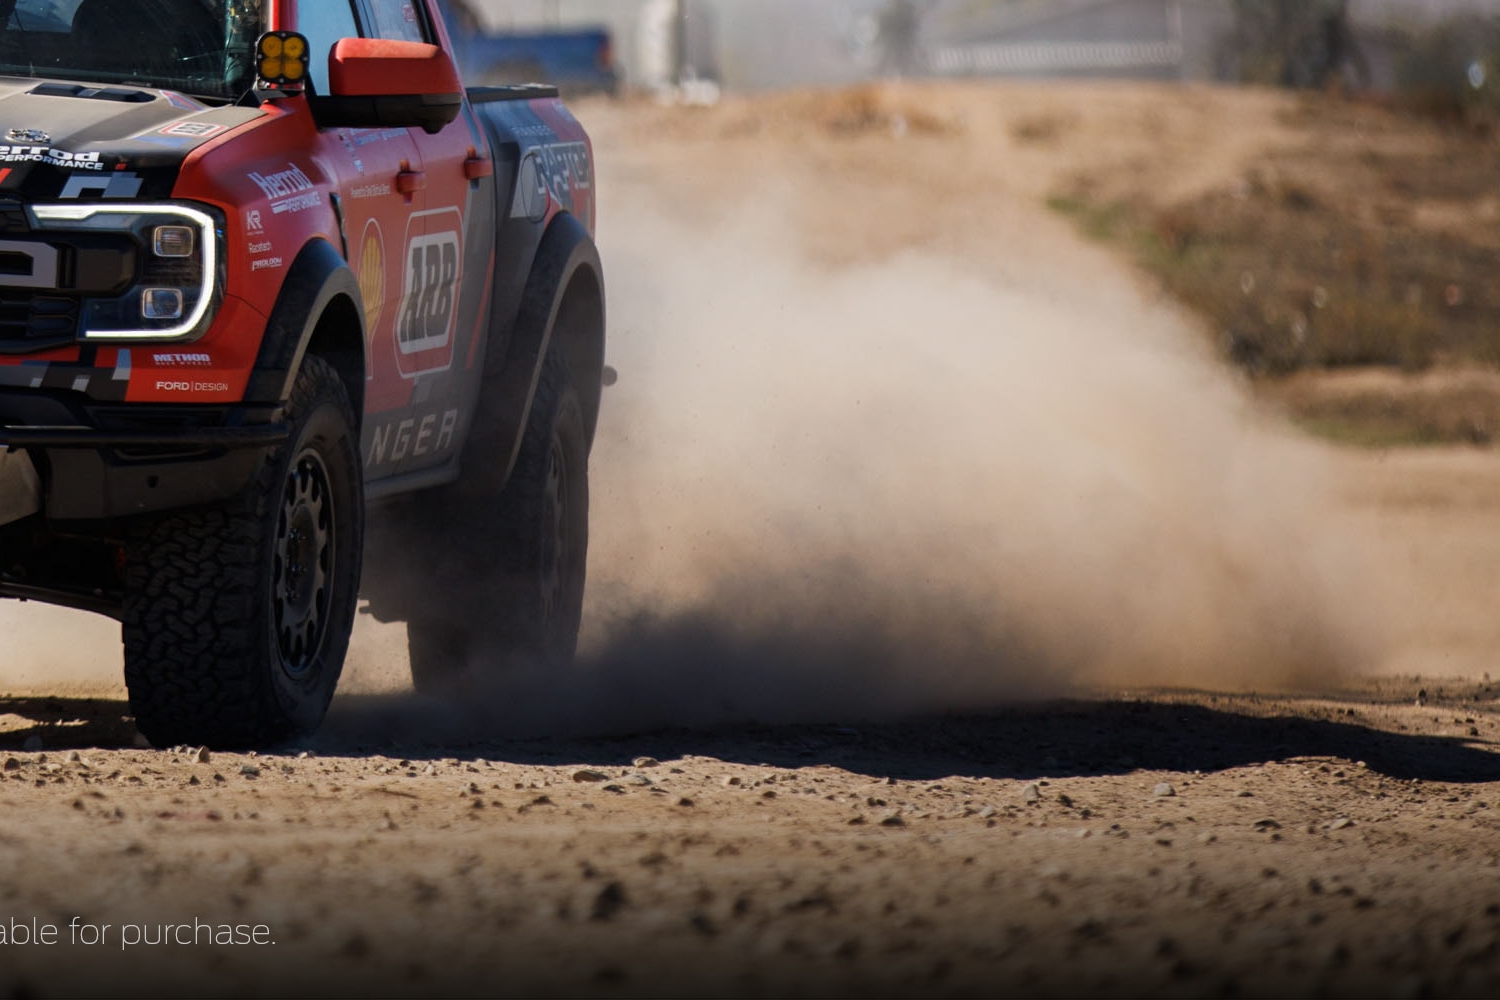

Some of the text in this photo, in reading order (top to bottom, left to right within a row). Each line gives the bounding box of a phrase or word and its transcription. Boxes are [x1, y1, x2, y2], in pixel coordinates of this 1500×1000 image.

[247, 162, 315, 201] Herrod
[400, 242, 457, 343] ARB
[153, 353, 211, 362] METHOD
[156, 381, 229, 392] FORD DESIGN
[365, 408, 458, 468] NGER
